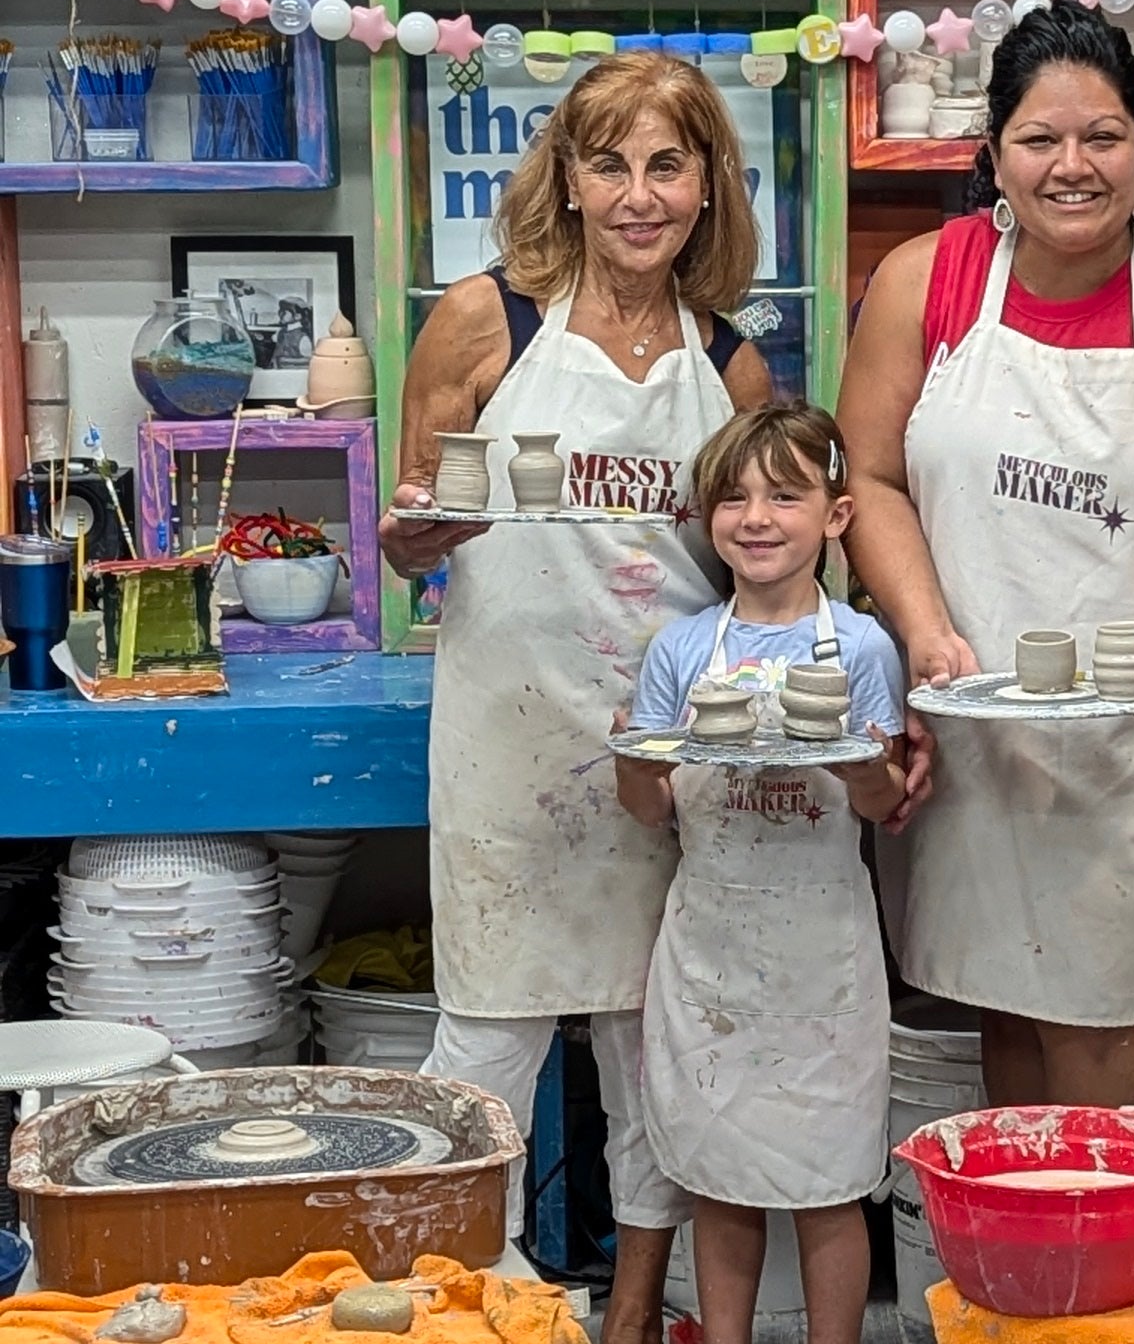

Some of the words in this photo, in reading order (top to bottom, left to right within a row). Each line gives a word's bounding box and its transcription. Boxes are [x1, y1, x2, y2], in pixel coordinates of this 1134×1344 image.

[568, 451, 683, 488] MESSY
[997, 452, 1109, 491] METICULOUS
[568, 480, 679, 515] MAKER
[993, 469, 1105, 516] MAKER
[723, 790, 808, 814] MAKER
